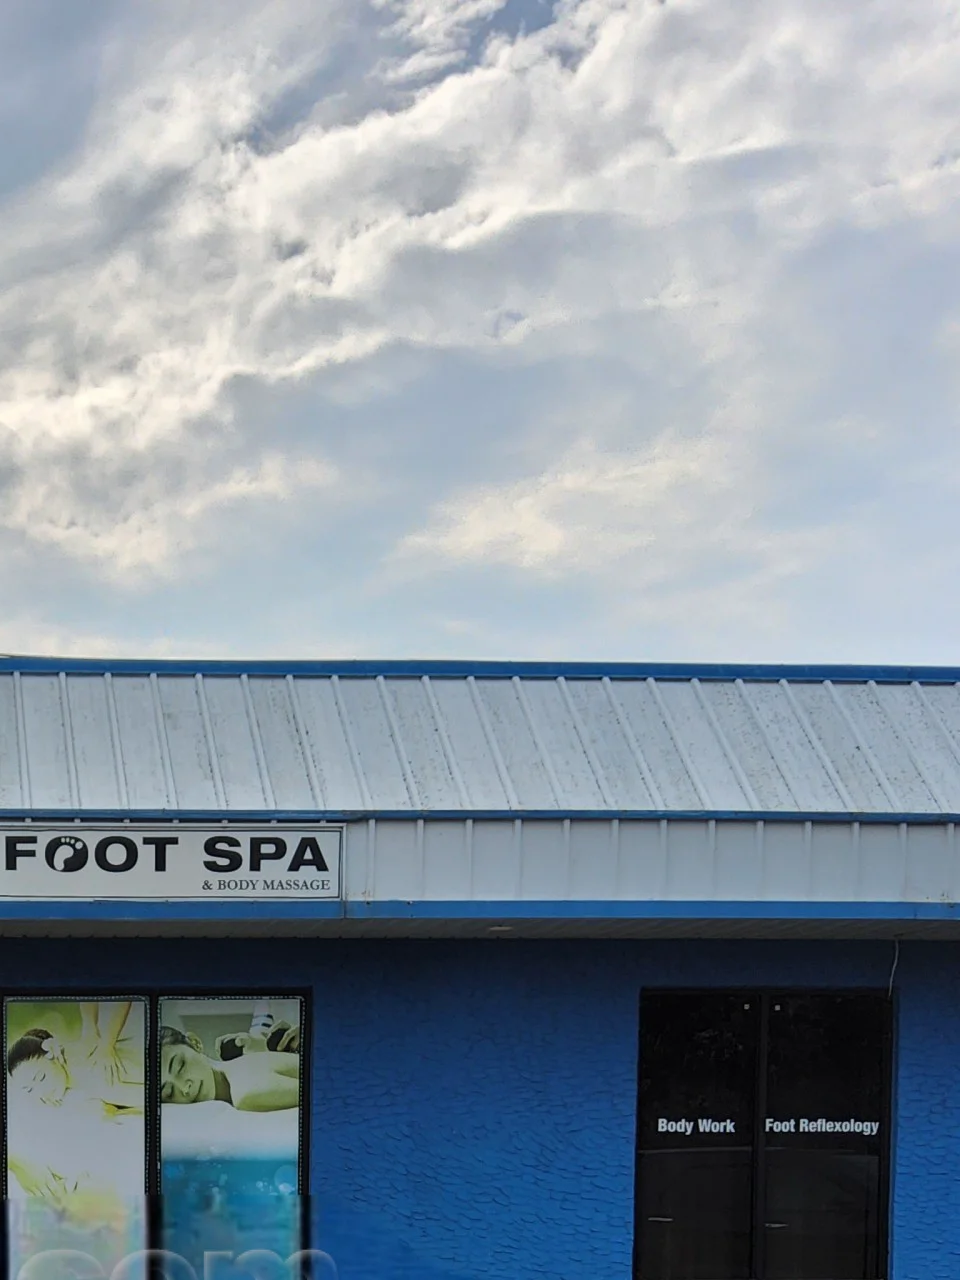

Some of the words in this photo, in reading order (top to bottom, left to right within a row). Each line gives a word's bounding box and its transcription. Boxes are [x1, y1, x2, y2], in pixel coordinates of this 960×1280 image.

[5, 835, 179, 873] FOOT
[202, 835, 330, 873] SPA
[201, 880, 214, 891] &
[217, 879, 259, 891] BODY
[262, 880, 331, 891] MASSAGE
[657, 1118, 694, 1135] Body
[697, 1118, 736, 1133] Work
[764, 1118, 795, 1133] Foot
[798, 1118, 880, 1136] Reflexology
